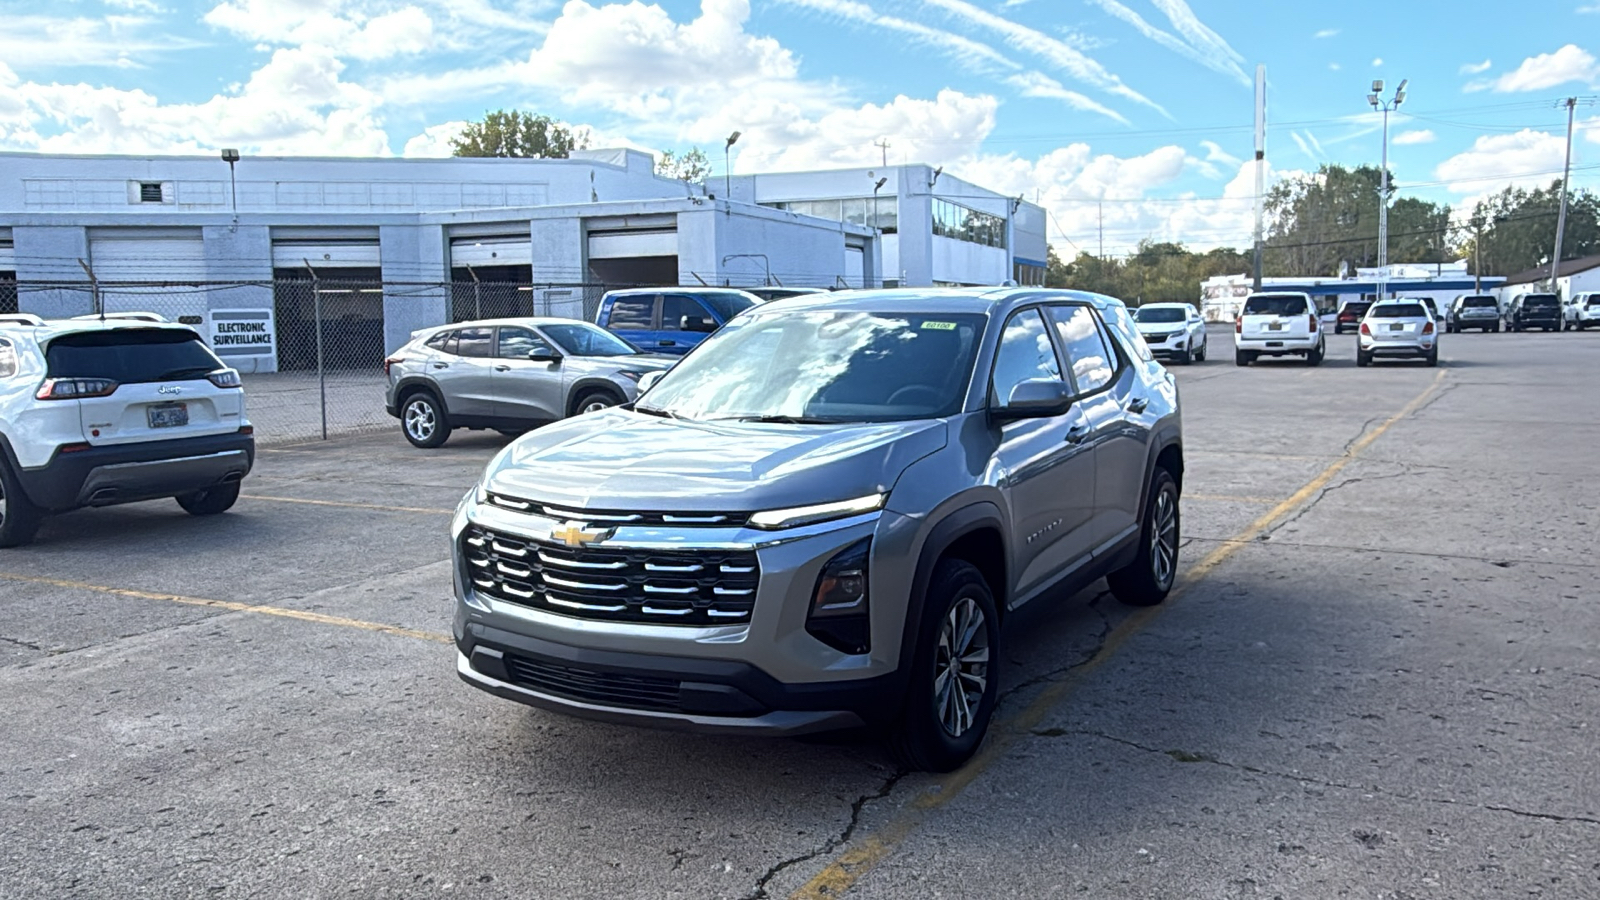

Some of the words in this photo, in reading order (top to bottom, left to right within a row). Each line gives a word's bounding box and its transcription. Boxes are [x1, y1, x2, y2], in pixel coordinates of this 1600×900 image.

[217, 322, 266, 333] ELECTRONIC
[213, 334, 272, 345] SURVEILLANCE
[158, 385, 181, 395] Jeep
